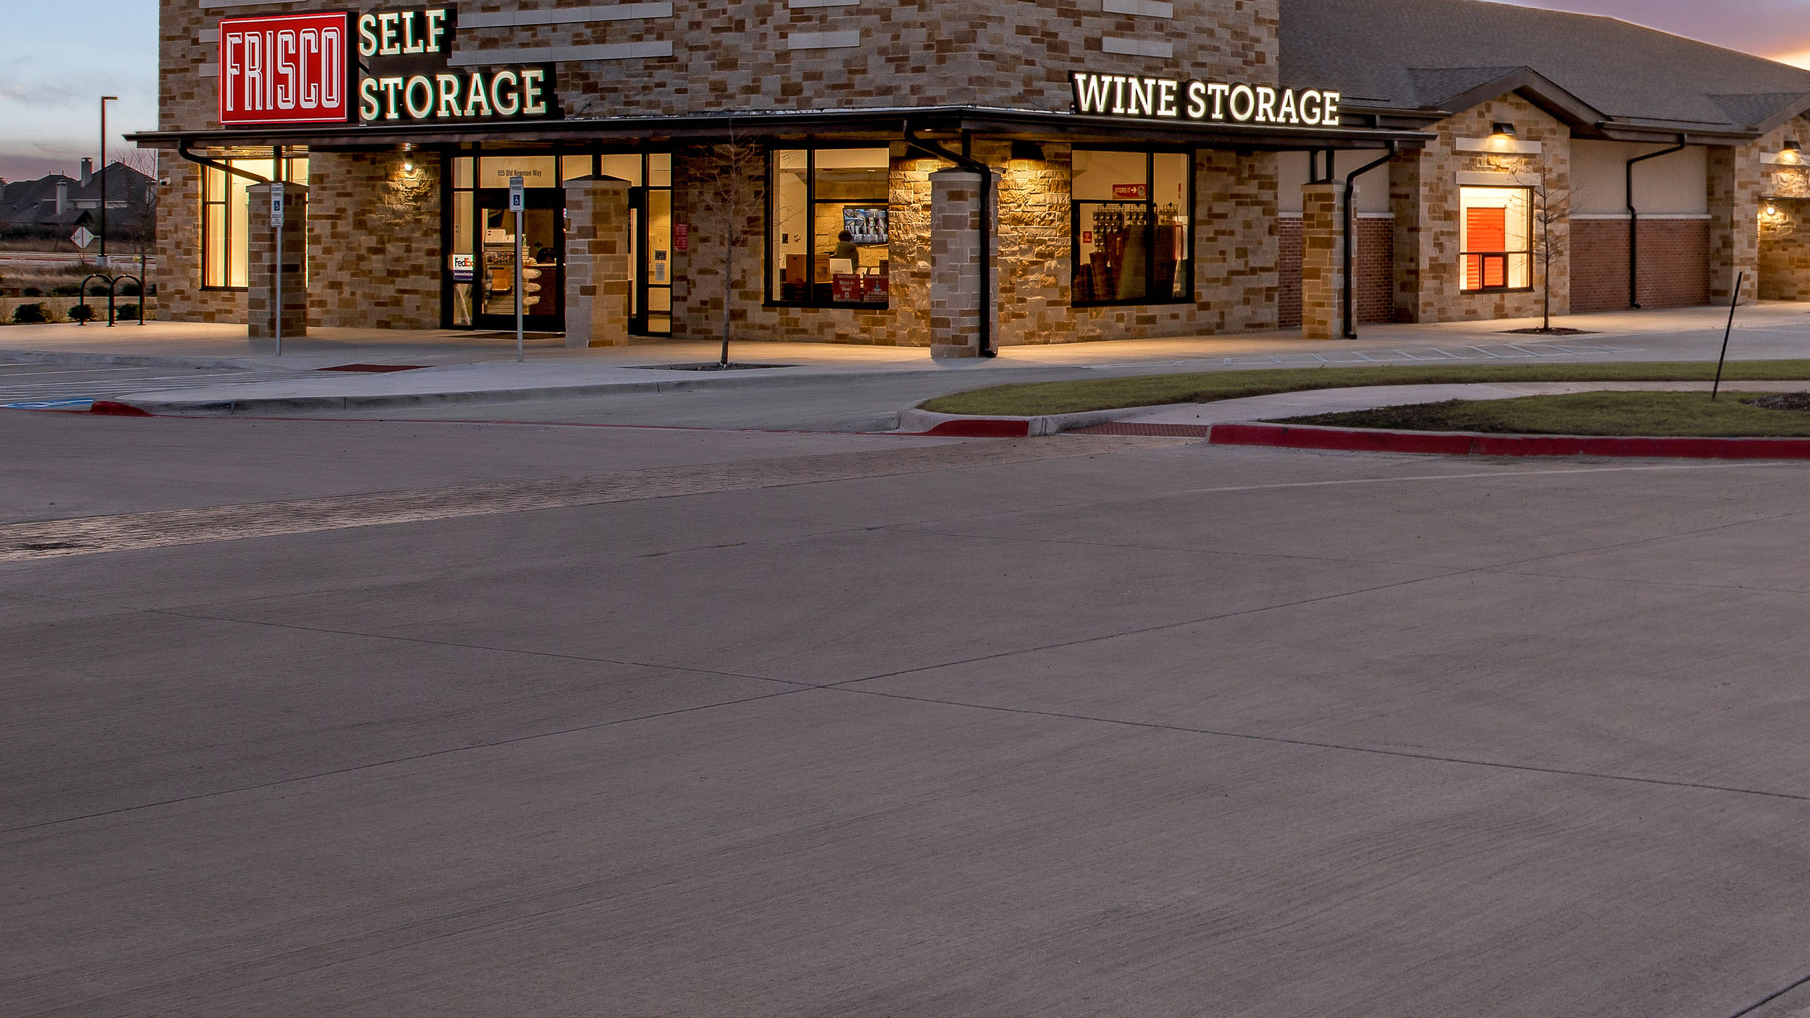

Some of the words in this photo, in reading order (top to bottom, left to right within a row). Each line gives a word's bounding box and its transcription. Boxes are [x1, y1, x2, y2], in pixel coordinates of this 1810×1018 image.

[358, 9, 446, 57] SELF
[226, 26, 341, 112] FRISCO
[359, 69, 546, 120] STORAGE
[1074, 73, 1177, 117] WINE
[1186, 81, 1341, 126] STORAGE
